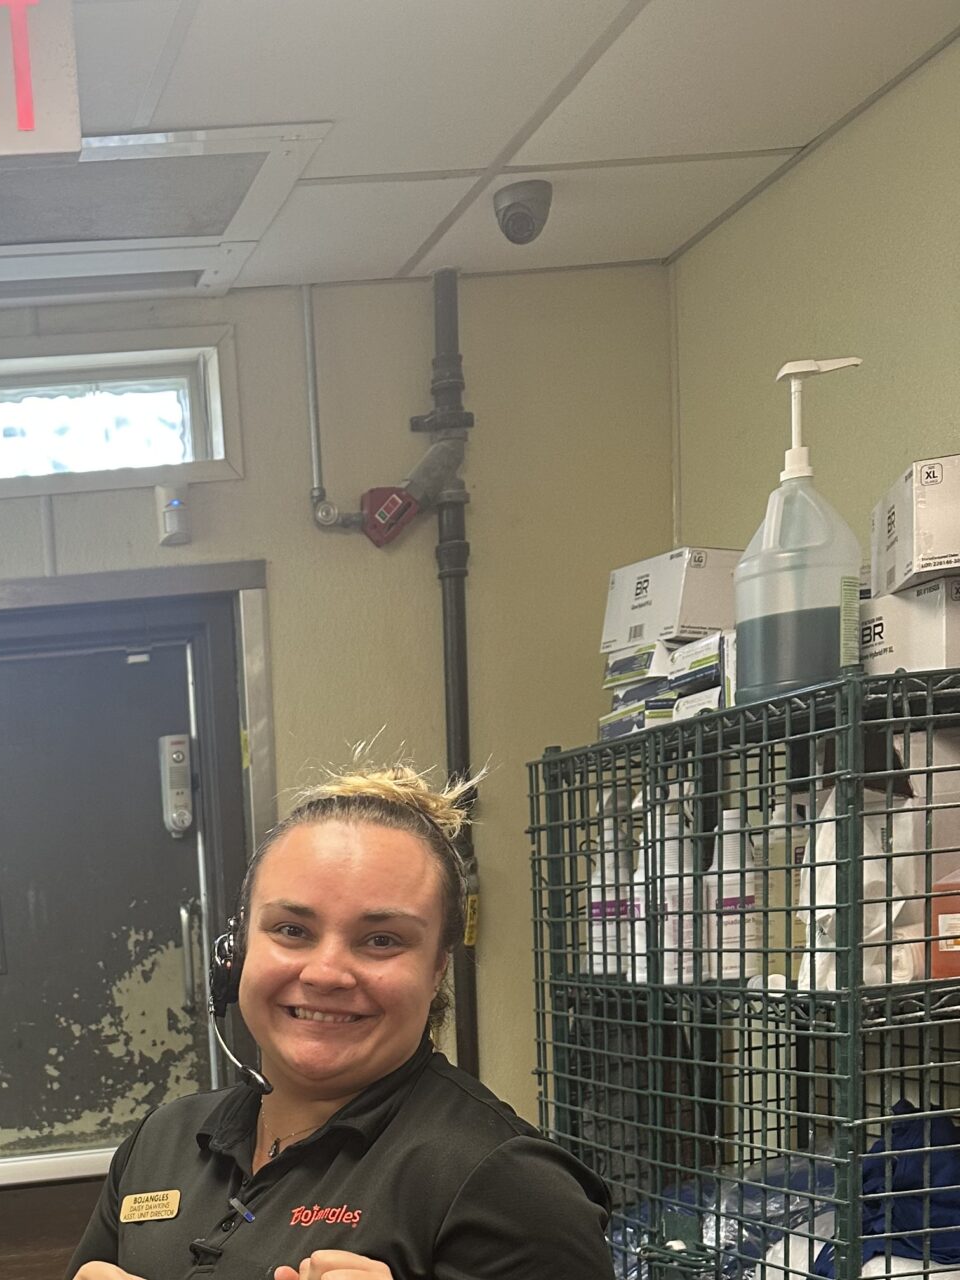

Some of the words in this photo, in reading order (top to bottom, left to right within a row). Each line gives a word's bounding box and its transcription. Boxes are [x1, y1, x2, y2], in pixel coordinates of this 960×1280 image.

[925, 470, 938, 480] XL
[693, 555, 704, 563] LG
[635, 579, 650, 597] BR
[861, 622, 884, 646] BR
[133, 1193, 169, 1205] BOJANGLES
